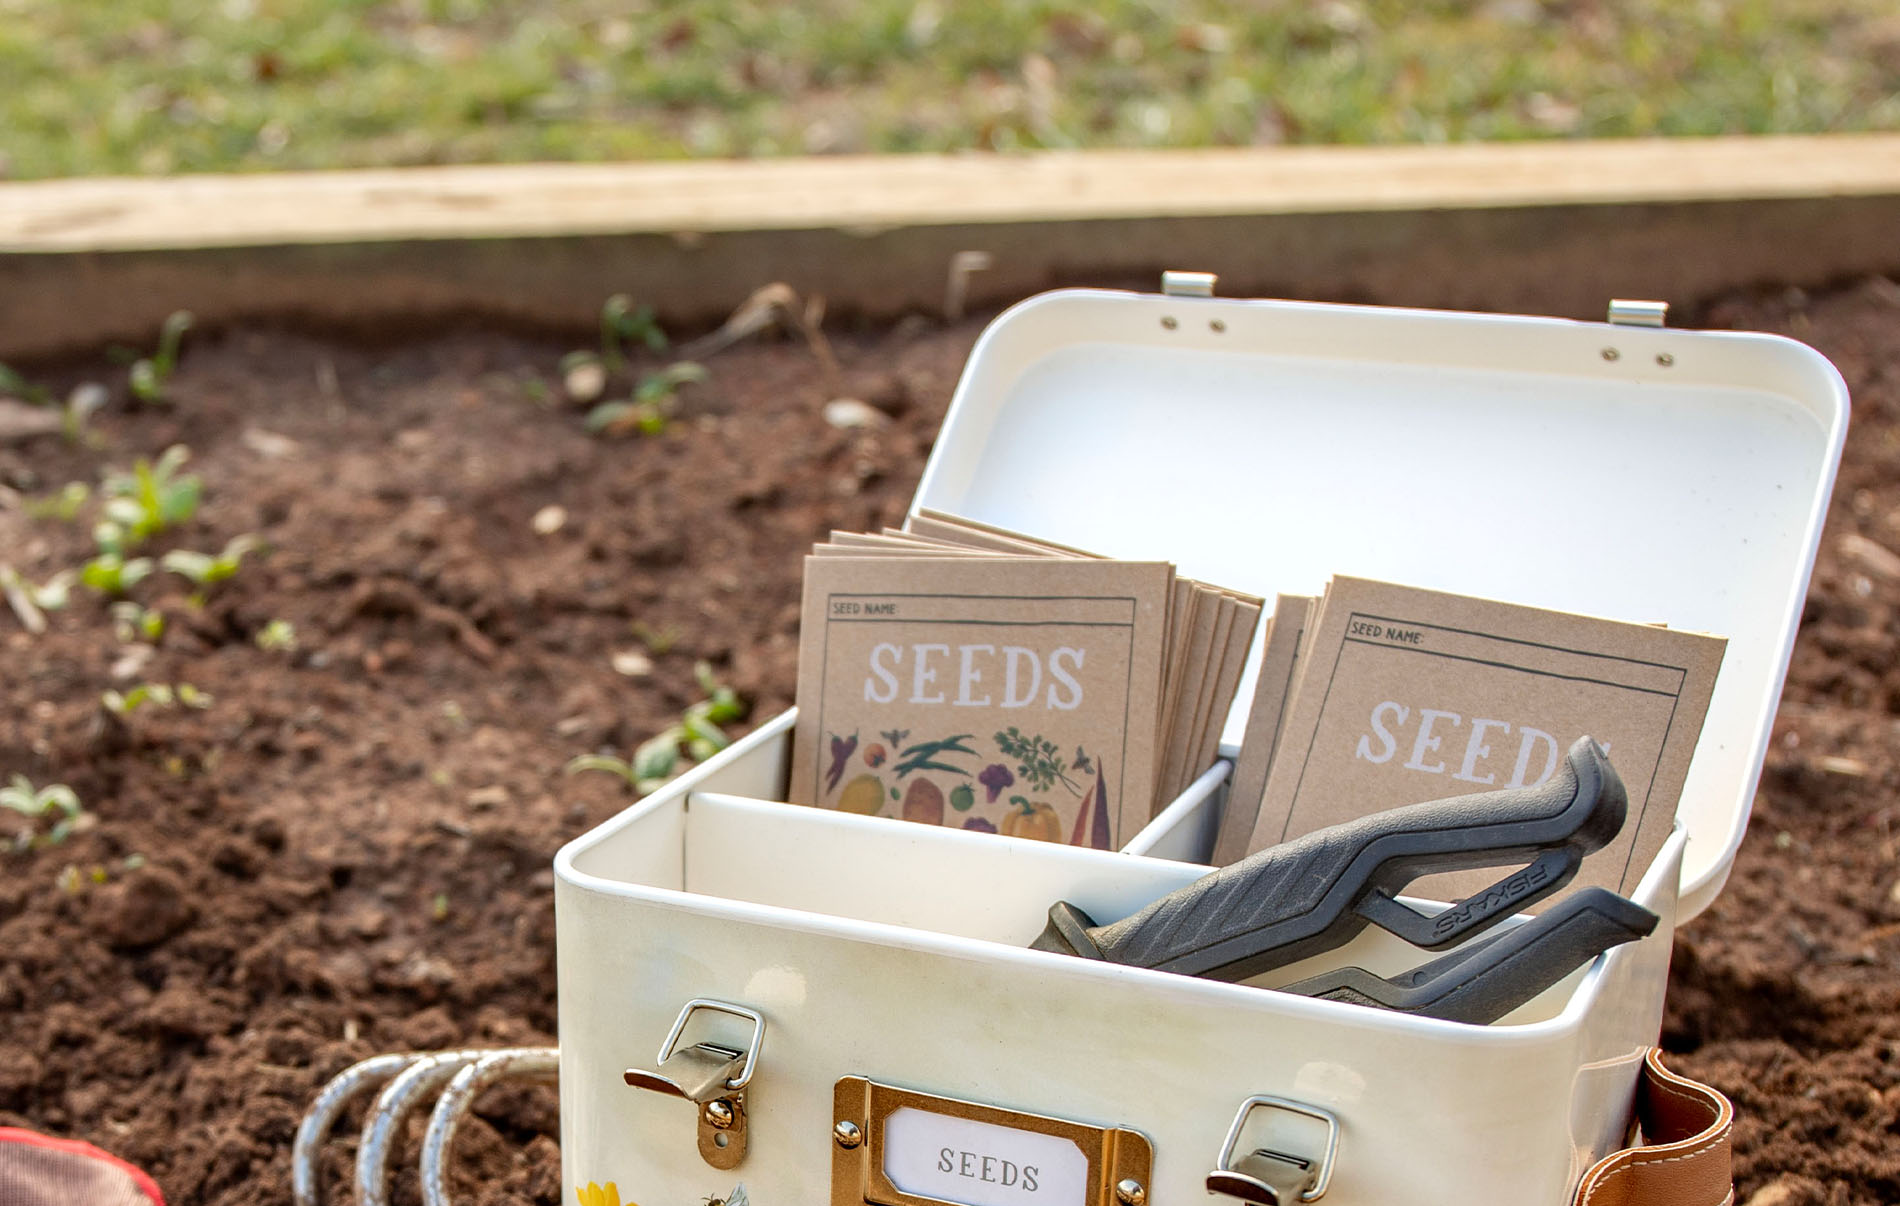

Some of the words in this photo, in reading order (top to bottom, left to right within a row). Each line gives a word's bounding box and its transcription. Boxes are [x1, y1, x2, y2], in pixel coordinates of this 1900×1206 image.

[833, 602, 860, 614] SEED
[1351, 621, 1382, 637] SEED
[863, 642, 1085, 710] SEEDS
[1356, 701, 1612, 790] SEED
[1436, 864, 1548, 933] FISKARS
[937, 1147, 1039, 1192] SEEDS
